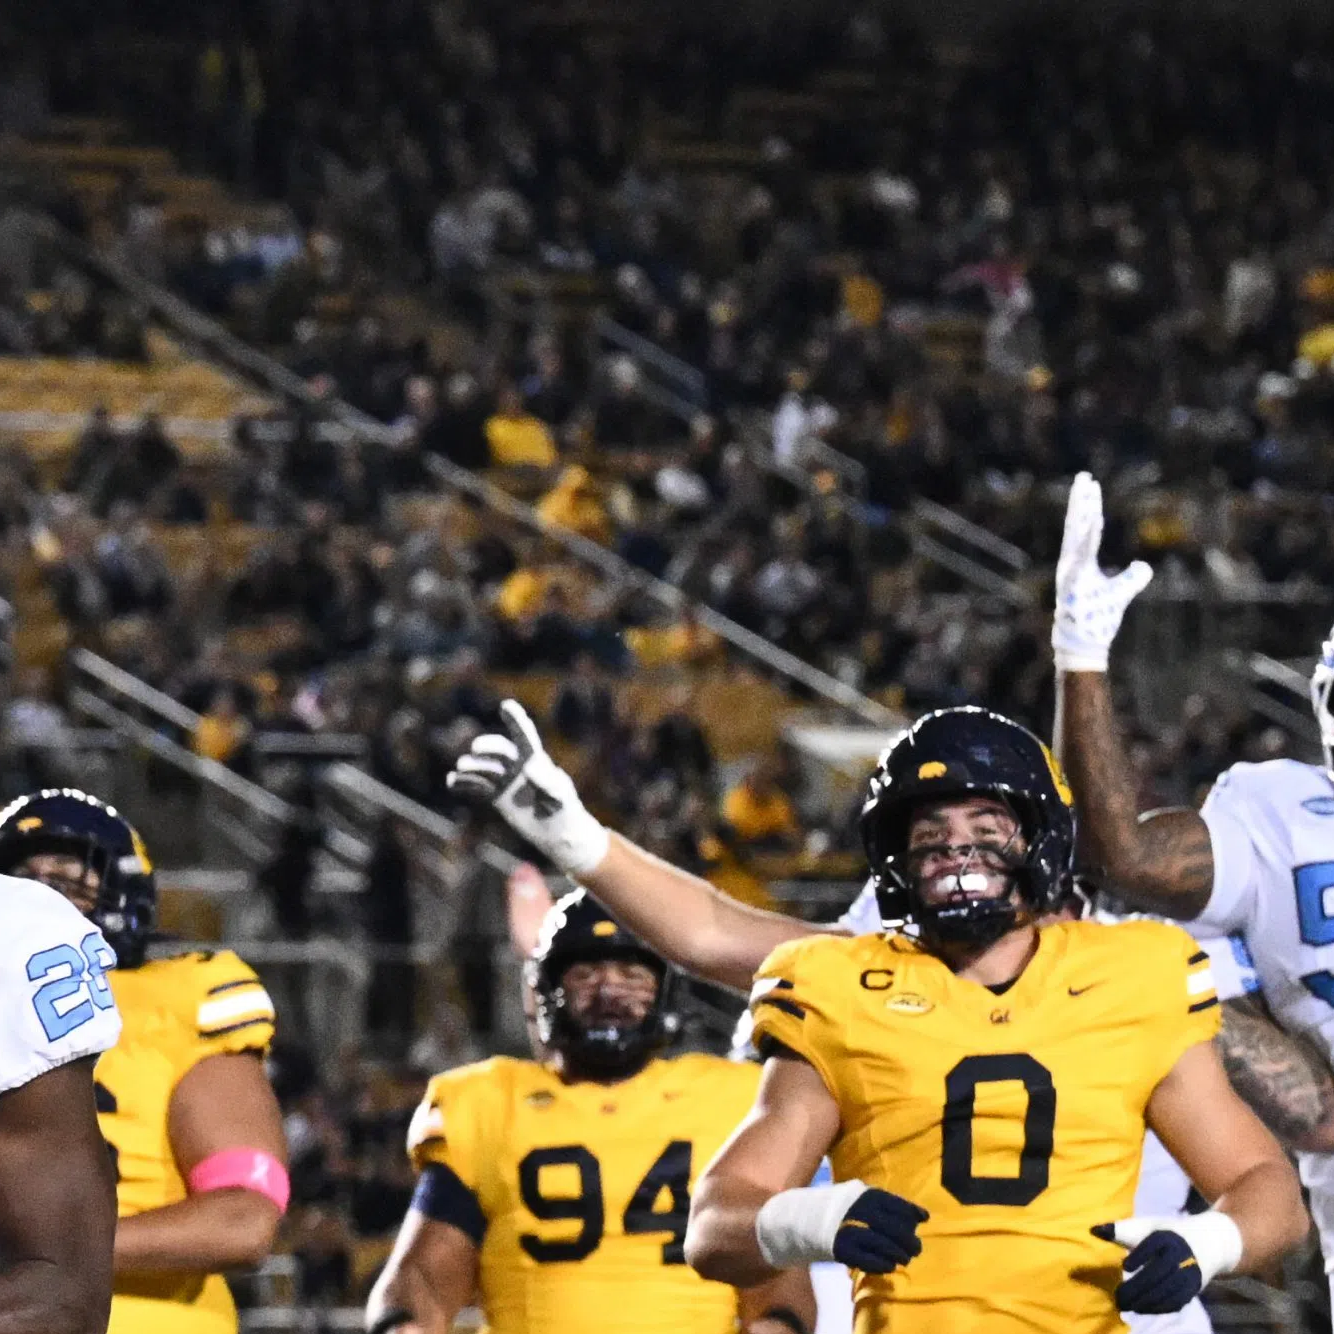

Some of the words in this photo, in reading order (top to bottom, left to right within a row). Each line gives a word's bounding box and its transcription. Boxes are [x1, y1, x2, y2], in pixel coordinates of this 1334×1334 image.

[25, 931, 117, 1043] 28
[860, 969, 894, 990] C
[990, 1008, 1011, 1026] Cal
[941, 1052, 1057, 1206] 0
[518, 1140, 693, 1265] 94
